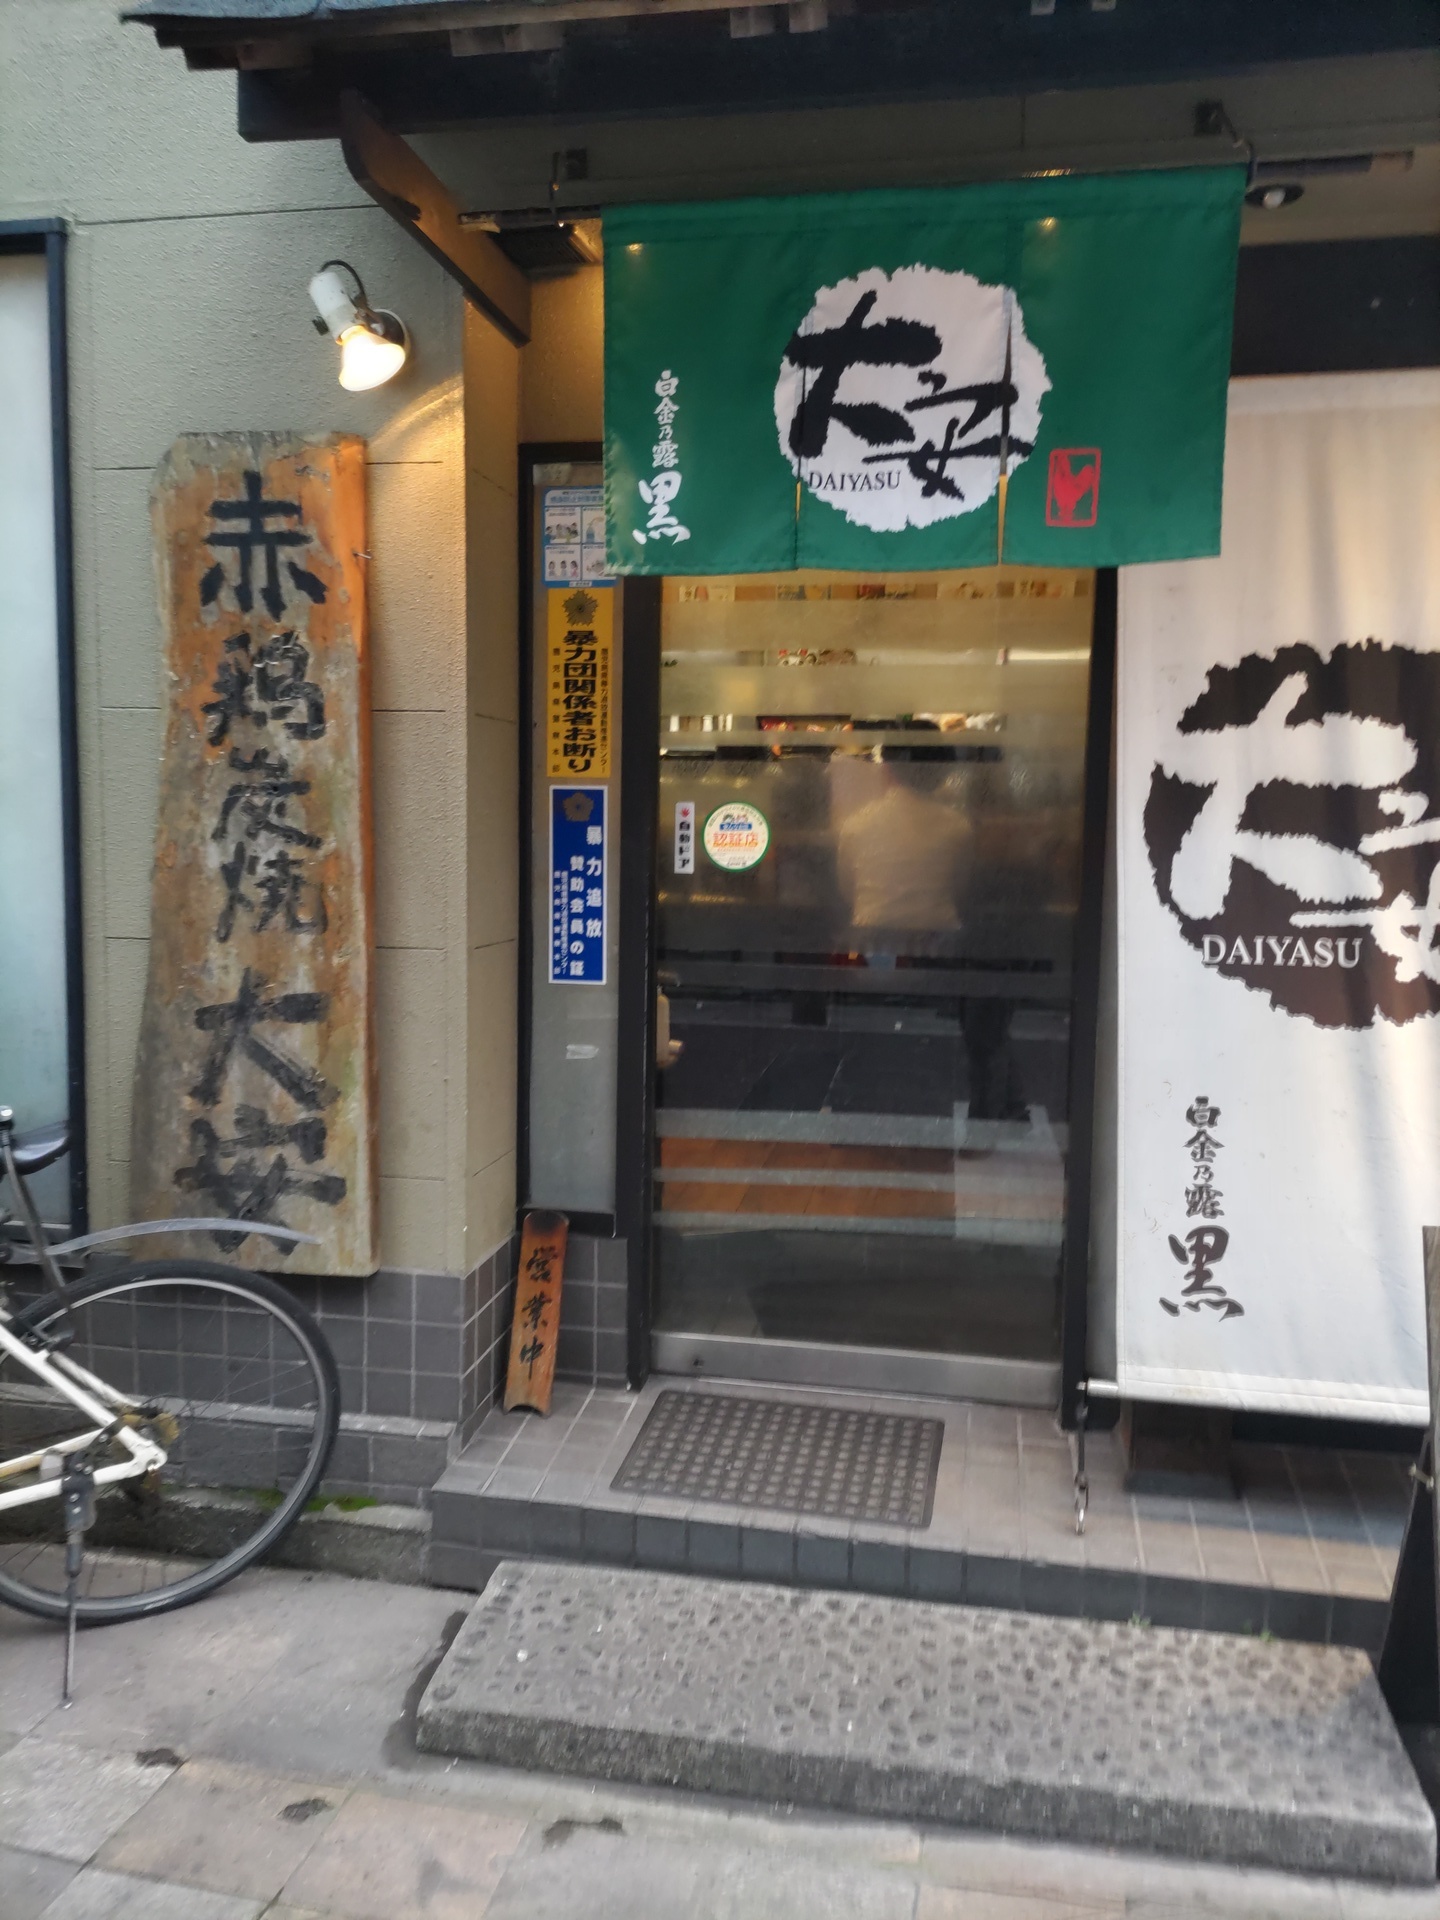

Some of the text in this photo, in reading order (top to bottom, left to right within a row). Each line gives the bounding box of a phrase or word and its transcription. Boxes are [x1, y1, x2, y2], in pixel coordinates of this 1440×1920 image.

[807, 468, 903, 494] DAIYASU
[562, 630, 599, 775] 暴力団関係者お断り
[585, 825, 603, 939] 暴力追放
[1201, 934, 1363, 970] DAIYASU
